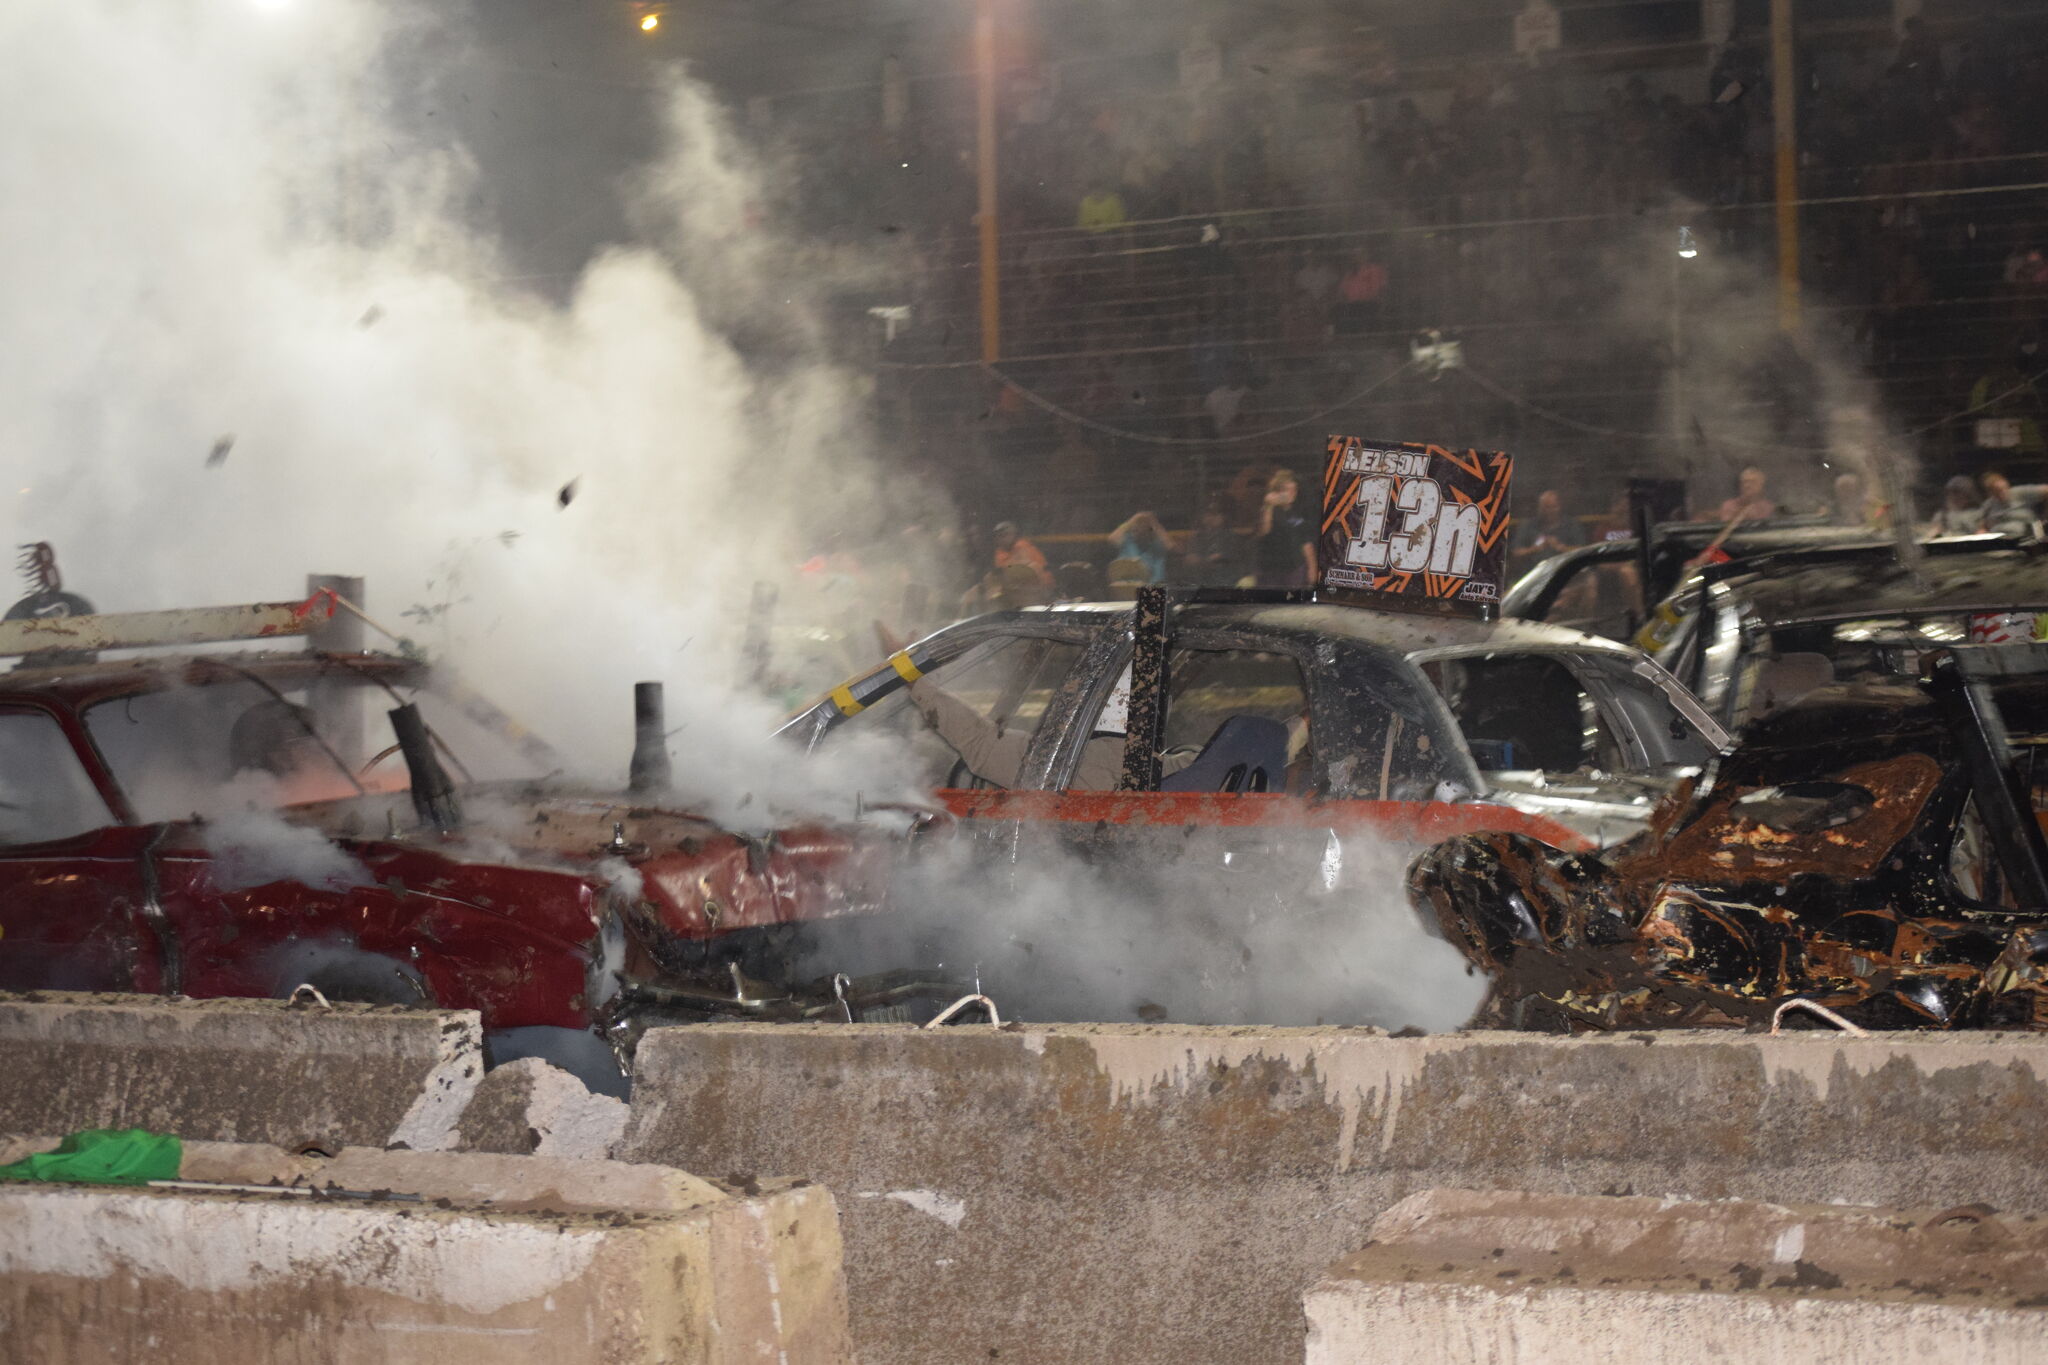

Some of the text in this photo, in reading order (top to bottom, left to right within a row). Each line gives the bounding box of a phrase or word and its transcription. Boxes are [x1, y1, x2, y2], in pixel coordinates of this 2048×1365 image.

[1343, 448, 1430, 477] NELSON
[1346, 475, 1481, 577] 13n
[1465, 583, 1495, 596] JAY'S
